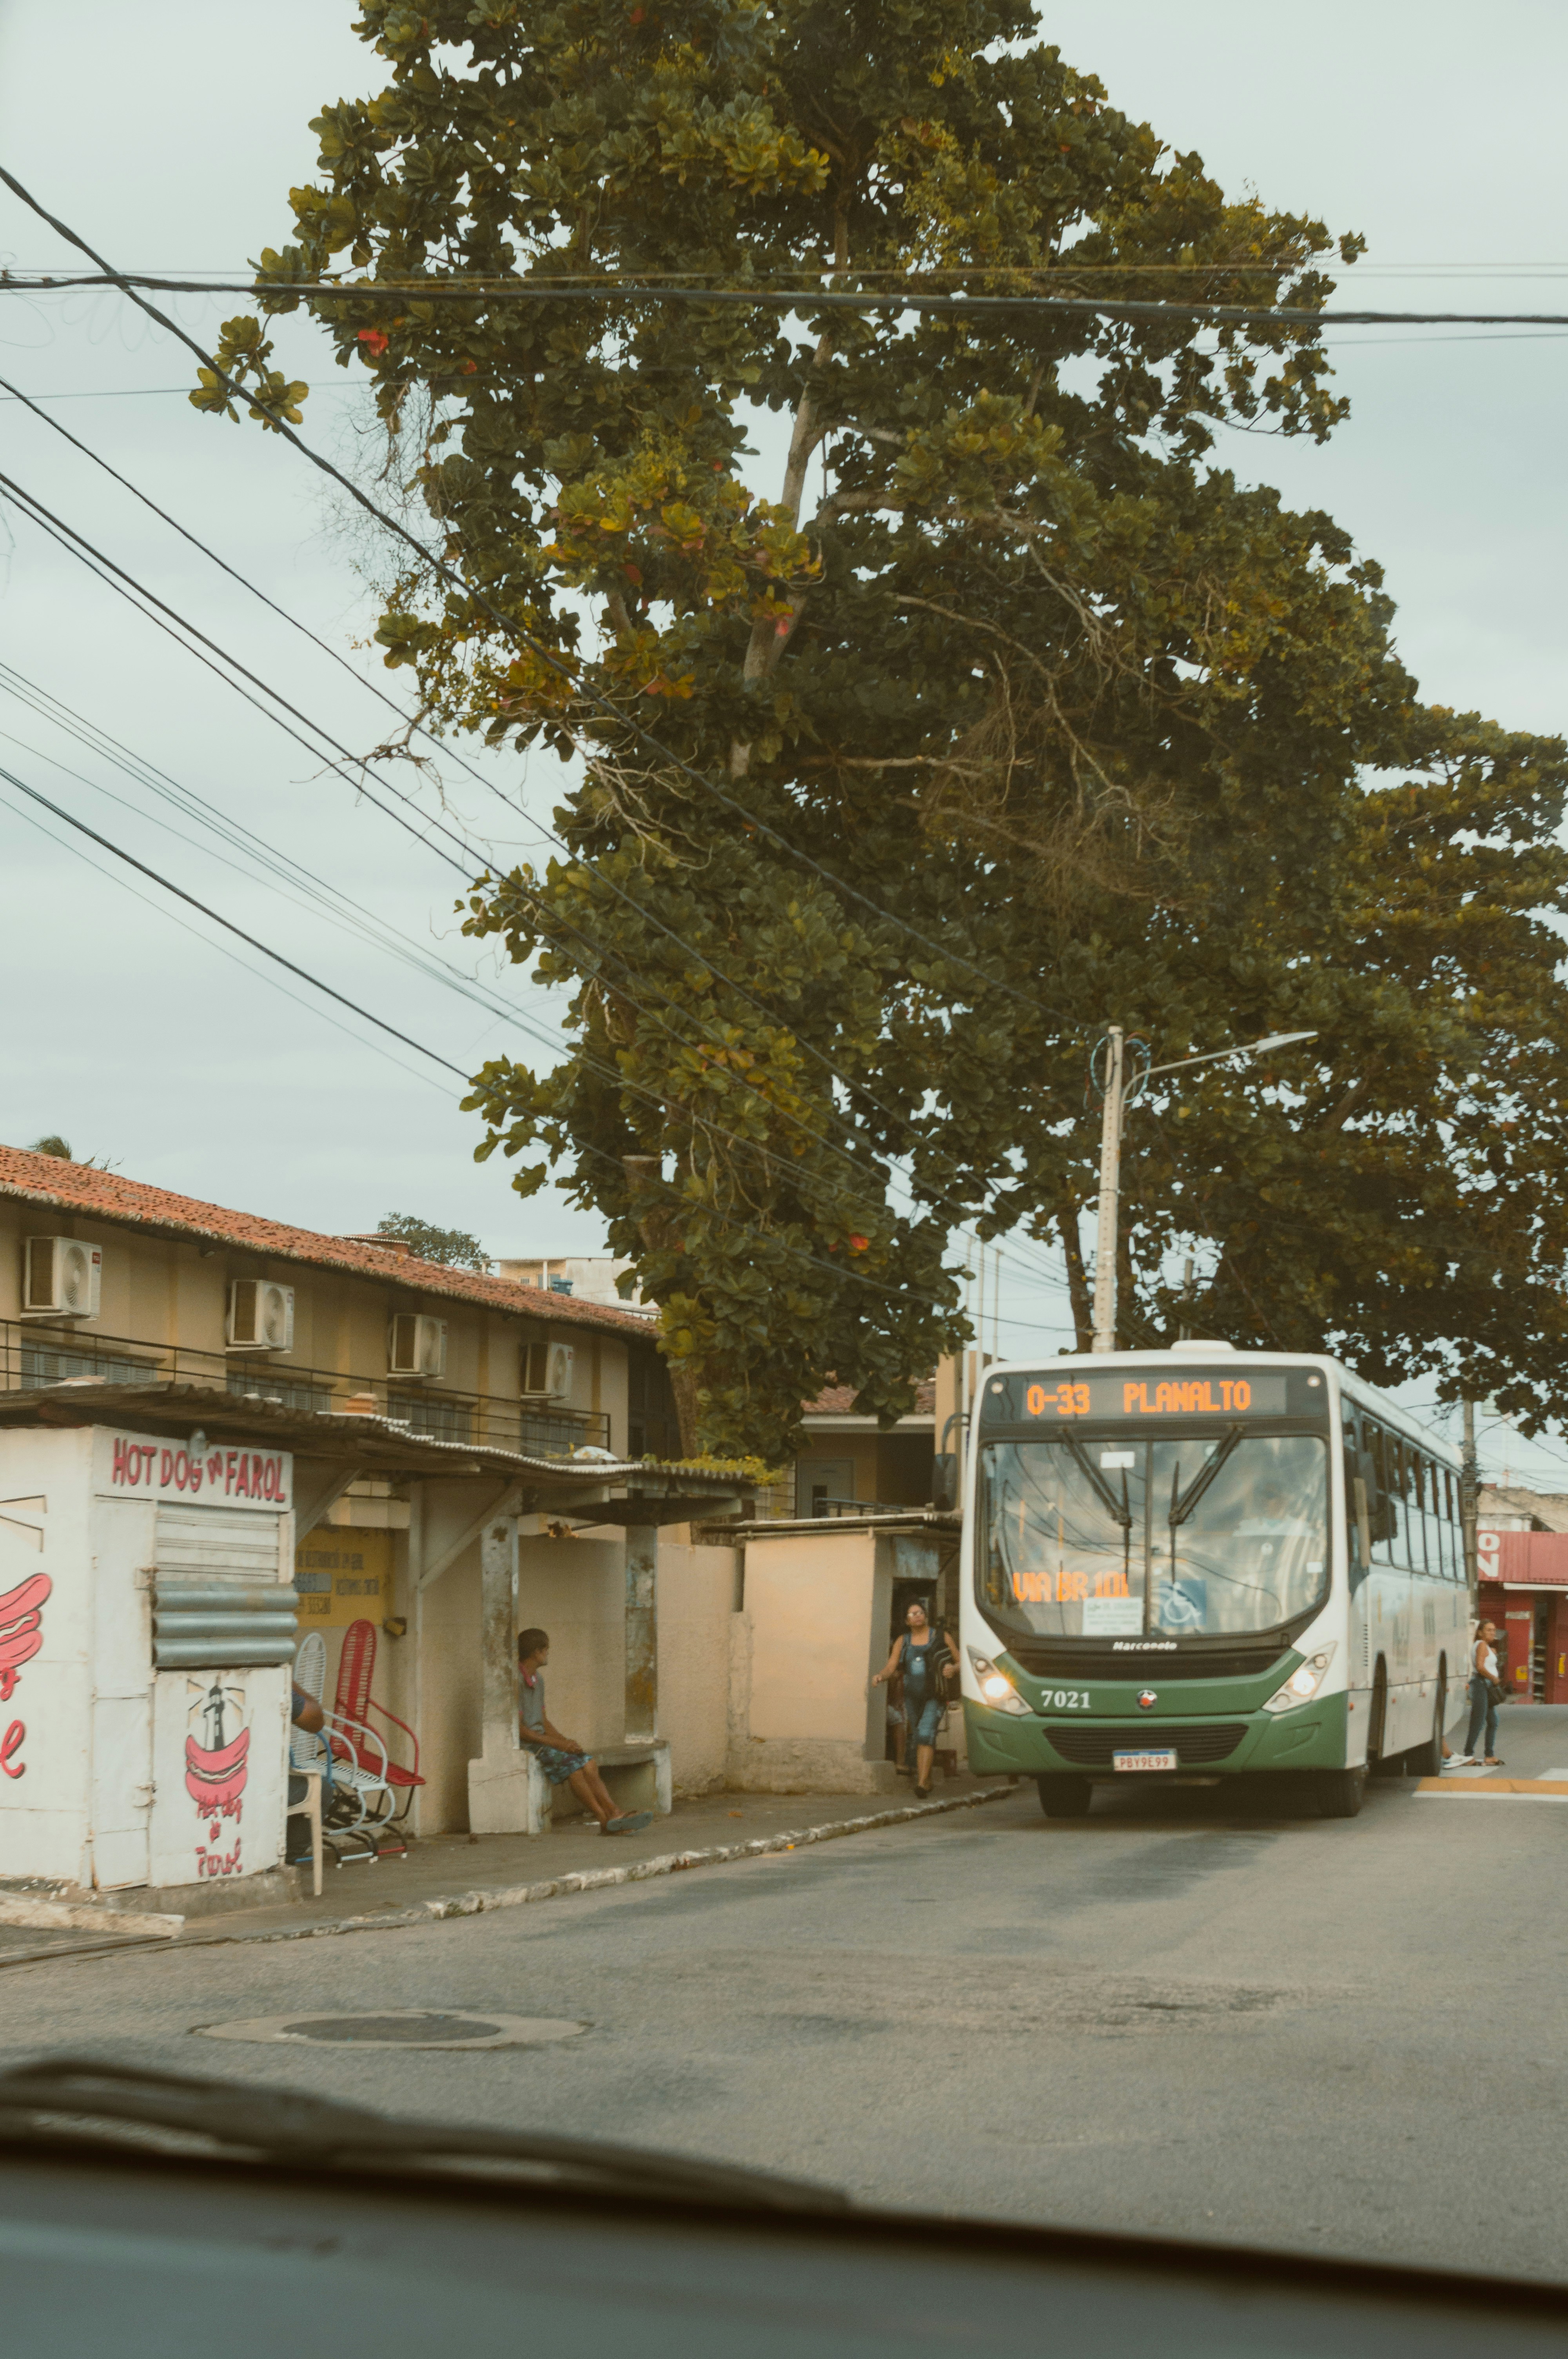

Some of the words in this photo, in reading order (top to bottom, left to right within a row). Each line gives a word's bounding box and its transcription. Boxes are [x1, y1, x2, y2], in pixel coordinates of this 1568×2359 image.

[1123, 1380, 1250, 1413] PLANALTO
[112, 1438, 157, 1486] HOT
[160, 1449, 203, 1493] DOG
[225, 1451, 285, 1503] FAROL
[1013, 1571, 1051, 1603] VIA
[1056, 1571, 1089, 1603] BR
[1093, 1570, 1130, 1598] 101
[1112, 1641, 1178, 1651] Marcopolo
[1041, 1690, 1091, 1709] 7021
